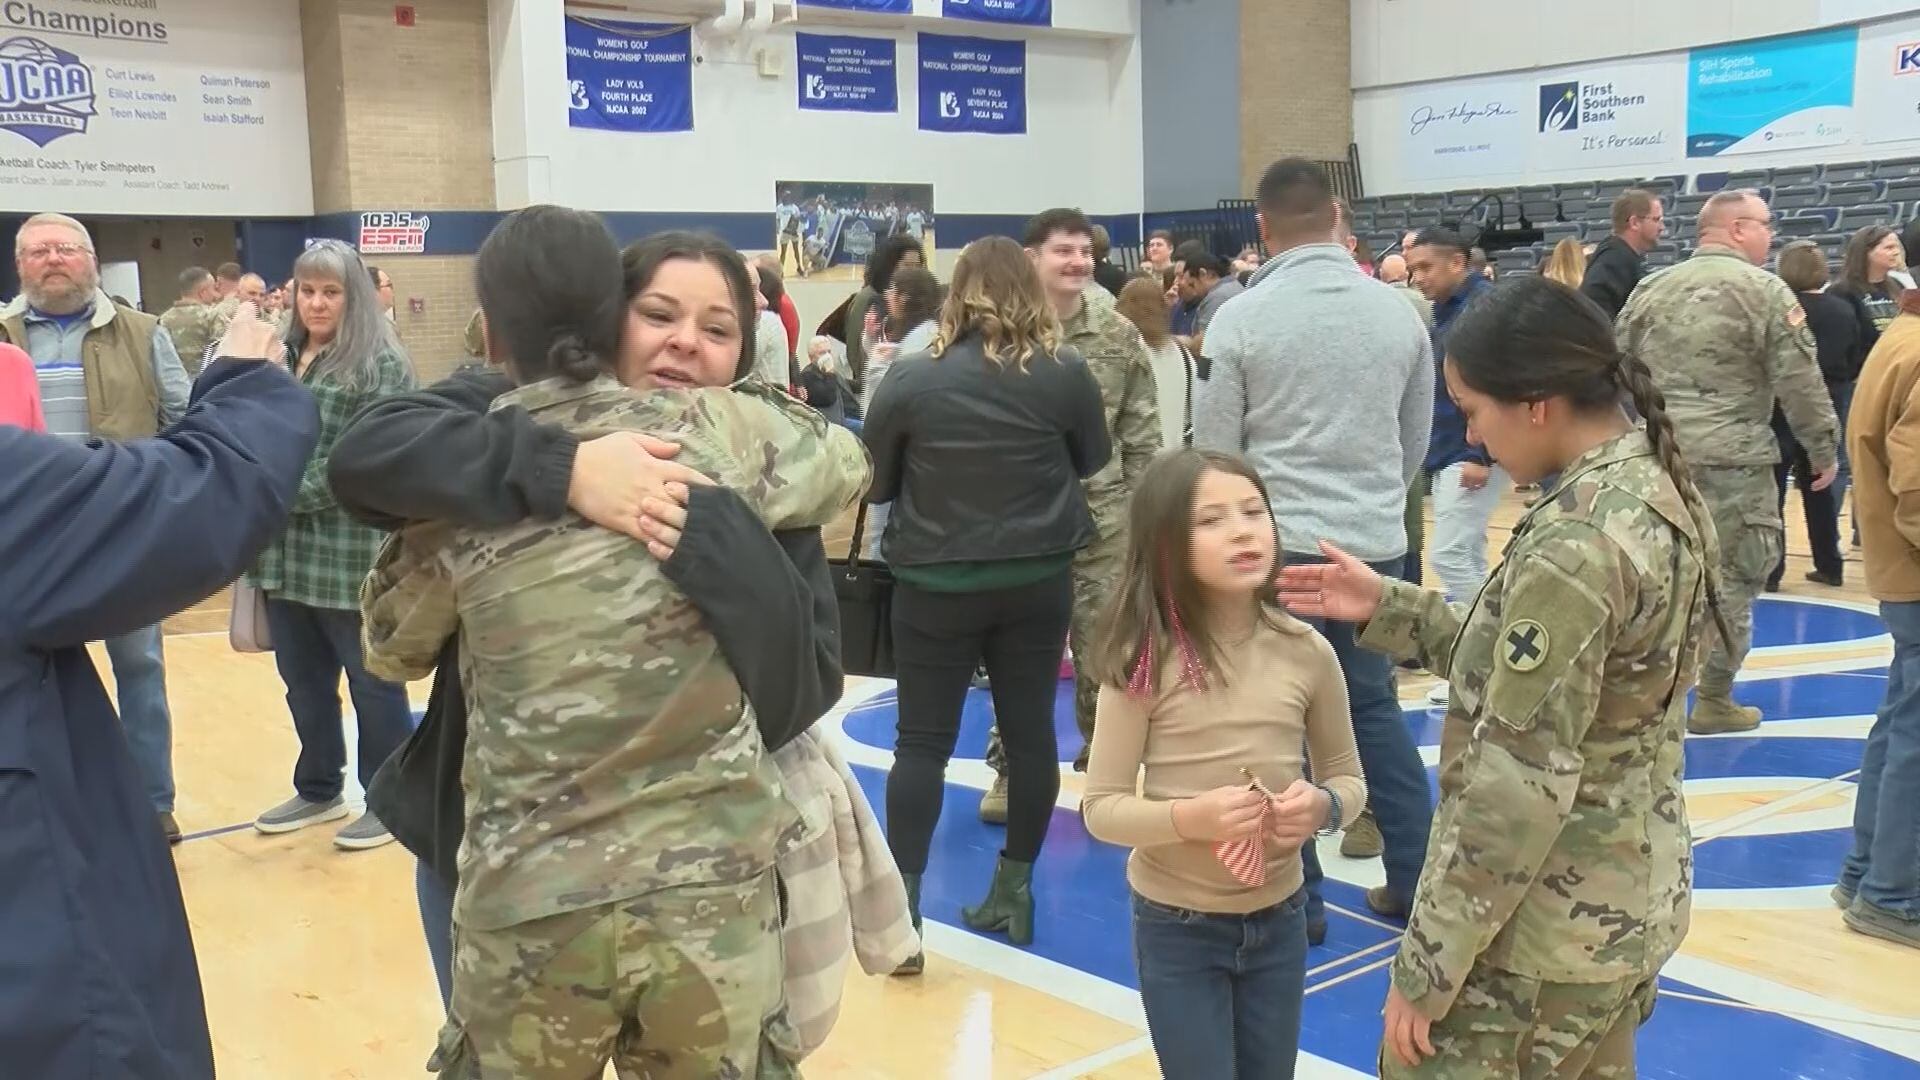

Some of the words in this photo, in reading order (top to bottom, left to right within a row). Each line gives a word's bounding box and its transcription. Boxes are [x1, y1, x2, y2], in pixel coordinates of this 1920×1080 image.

[4, 1, 168, 39] Champions
[597, 38, 628, 49] WOMEN'S
[631, 41, 649, 50] GOLF
[566, 46, 591, 58] TIONAL
[593, 50, 642, 63] CHAMPIONSHIP
[644, 54, 686, 63] TOURNAMENT
[923, 61, 949, 71] NATIONAL
[951, 63, 988, 72] CHAMPIONSHIP
[990, 66, 1022, 75] TOURNAMENT
[1720, 55, 1755, 70] Sports
[105, 68, 126, 80] Curt
[128, 70, 156, 82] Lewis
[1699, 67, 1773, 84] Rehabilitation
[0, 62, 87, 103] JCAA
[234, 76, 271, 89] Peterson
[606, 79, 624, 88] LADY
[626, 80, 644, 89] VOLS
[1583, 82, 1613, 97] First
[108, 87, 134, 100] Elliot
[135, 90, 177, 103] Lowndes
[203, 93, 225, 105] Sean
[227, 94, 252, 106] Smith
[601, 91, 630, 102] FOURTH
[631, 92, 653, 103] PLACE
[972, 88, 986, 96] LADY
[988, 89, 1001, 97] VOLS
[967, 99, 990, 108] SEVENTH
[991, 100, 1008, 109] PLACE
[1583, 94, 1645, 110] Southern
[110, 107, 133, 119] Teon
[135, 108, 167, 120] Nesbitt
[606, 105, 629, 115] NJCAA
[631, 106, 647, 115] 2002
[1582, 109, 1615, 123] Bank
[203, 113, 230, 124] Isaiah
[231, 113, 265, 125] Stafford
[1582, 136, 1604, 151] It's
[0, 156, 34, 168] ketball
[75, 159, 98, 173] Tyler
[100, 160, 156, 174] Smithpeters
[362, 213, 410, 227] 103.5
[362, 228, 424, 245] ESPN
